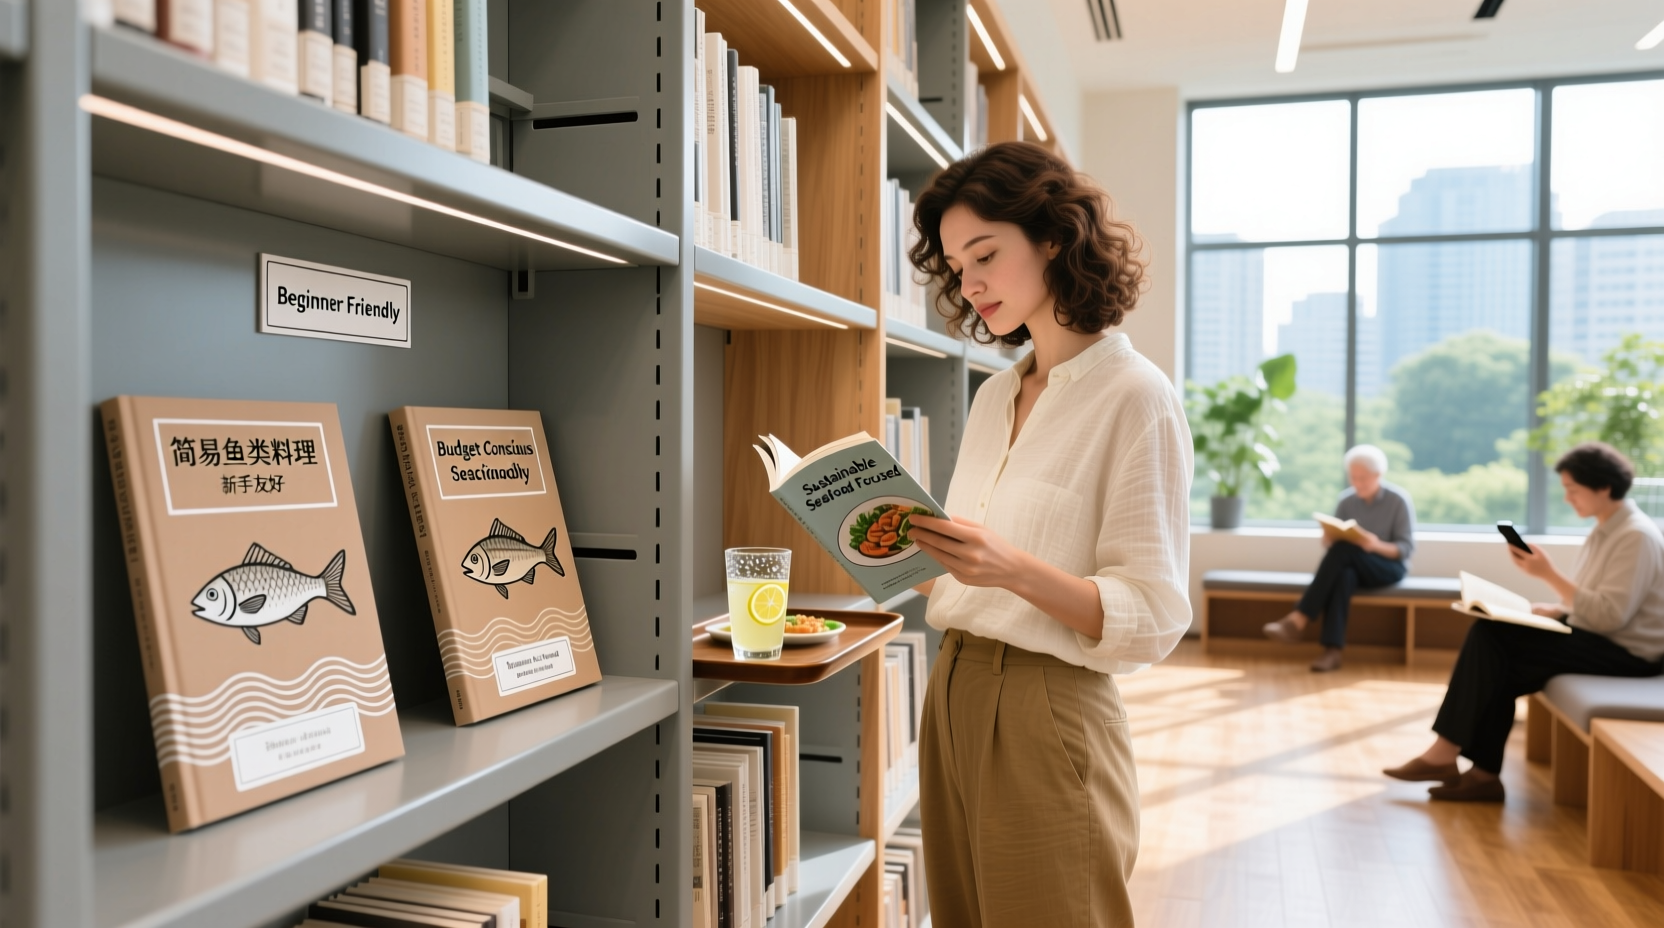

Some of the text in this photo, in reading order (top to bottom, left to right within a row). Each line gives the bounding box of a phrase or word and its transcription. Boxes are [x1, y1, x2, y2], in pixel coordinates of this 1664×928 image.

[277, 285, 401, 325] Beginner Friendly
[170, 436, 318, 467] 简易鱼类料理
[437, 439, 481, 461] Budget
[220, 474, 286, 495] 新手友好
[802, 458, 877, 495] Sustainable
